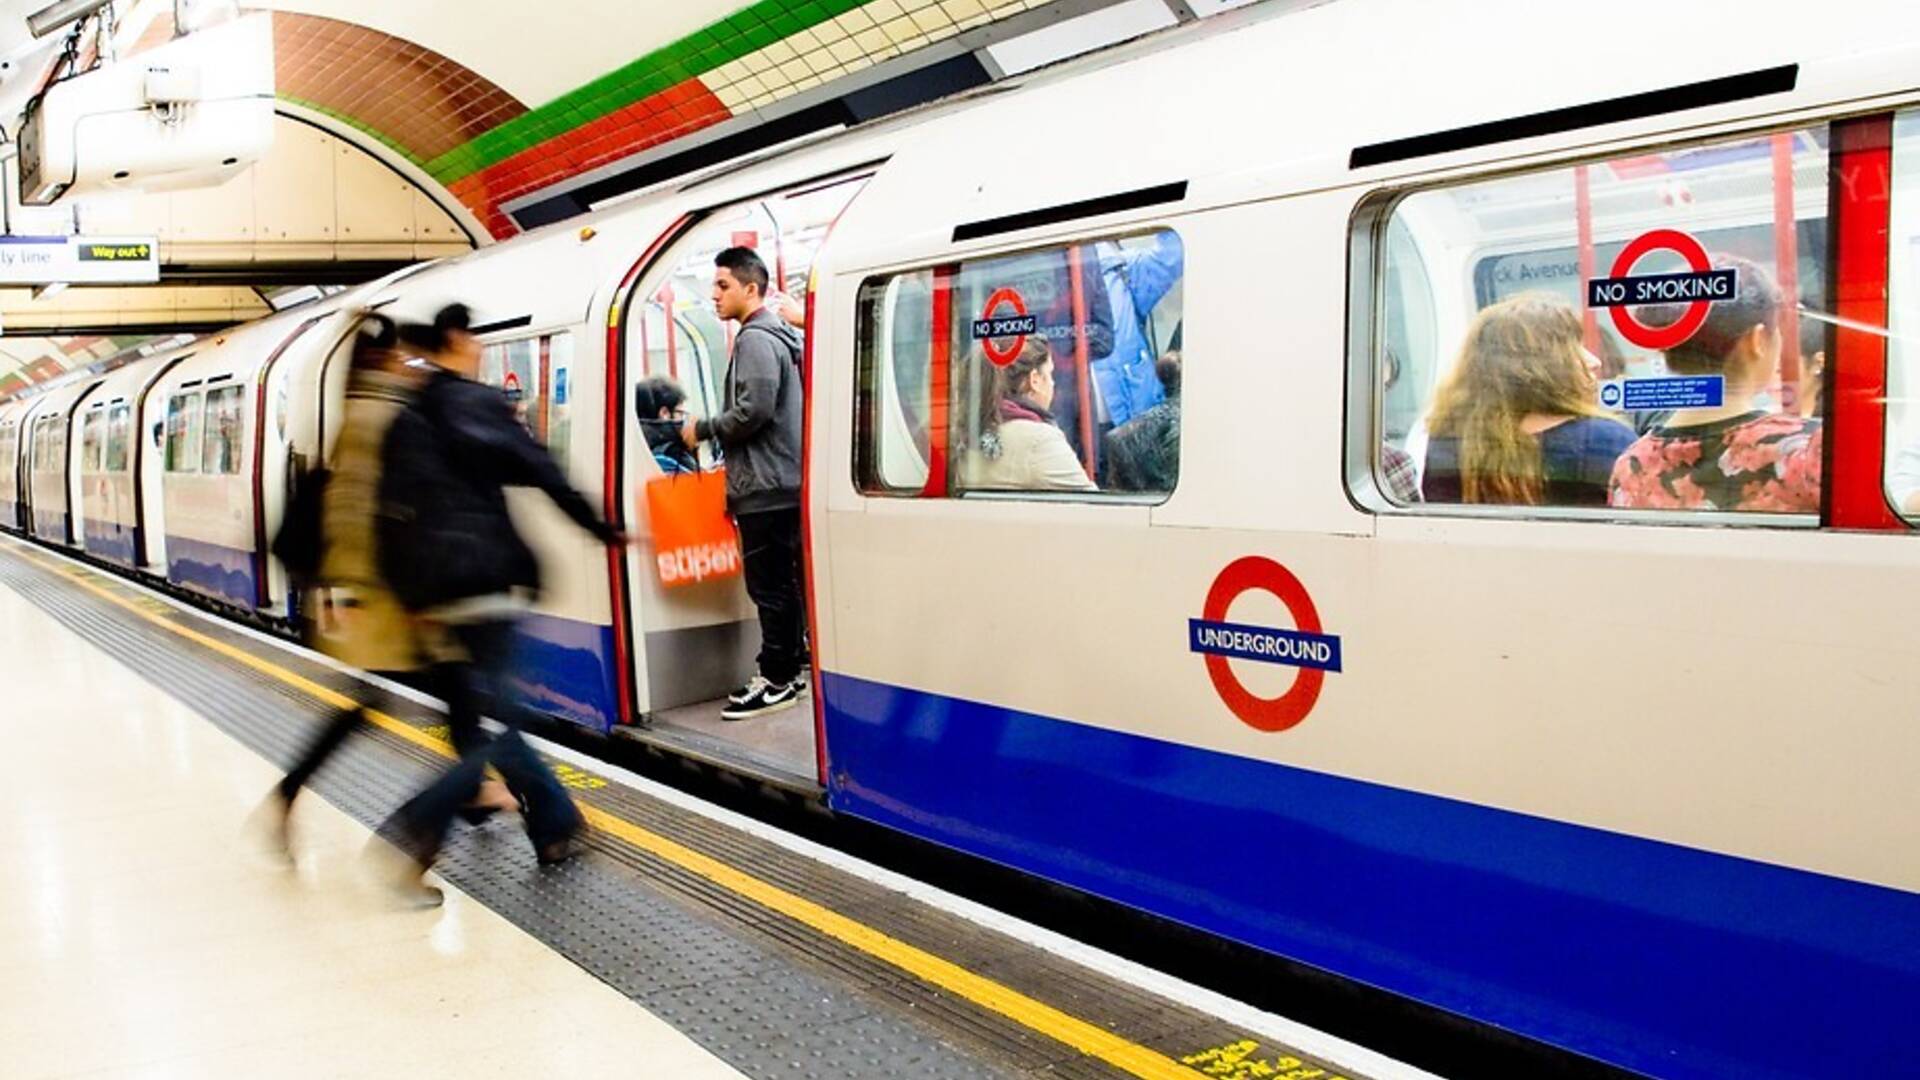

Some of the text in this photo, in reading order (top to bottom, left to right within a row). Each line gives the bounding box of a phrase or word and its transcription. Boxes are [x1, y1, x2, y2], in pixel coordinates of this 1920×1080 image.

[20, 248, 51, 264] line
[91, 246, 138, 259] Way out
[1595, 276, 1728, 303] NO SMOKING
[976, 321, 990, 335] NO
[993, 318, 1033, 334] SMOKING
[1197, 628, 1331, 662] UNDERGROUND
